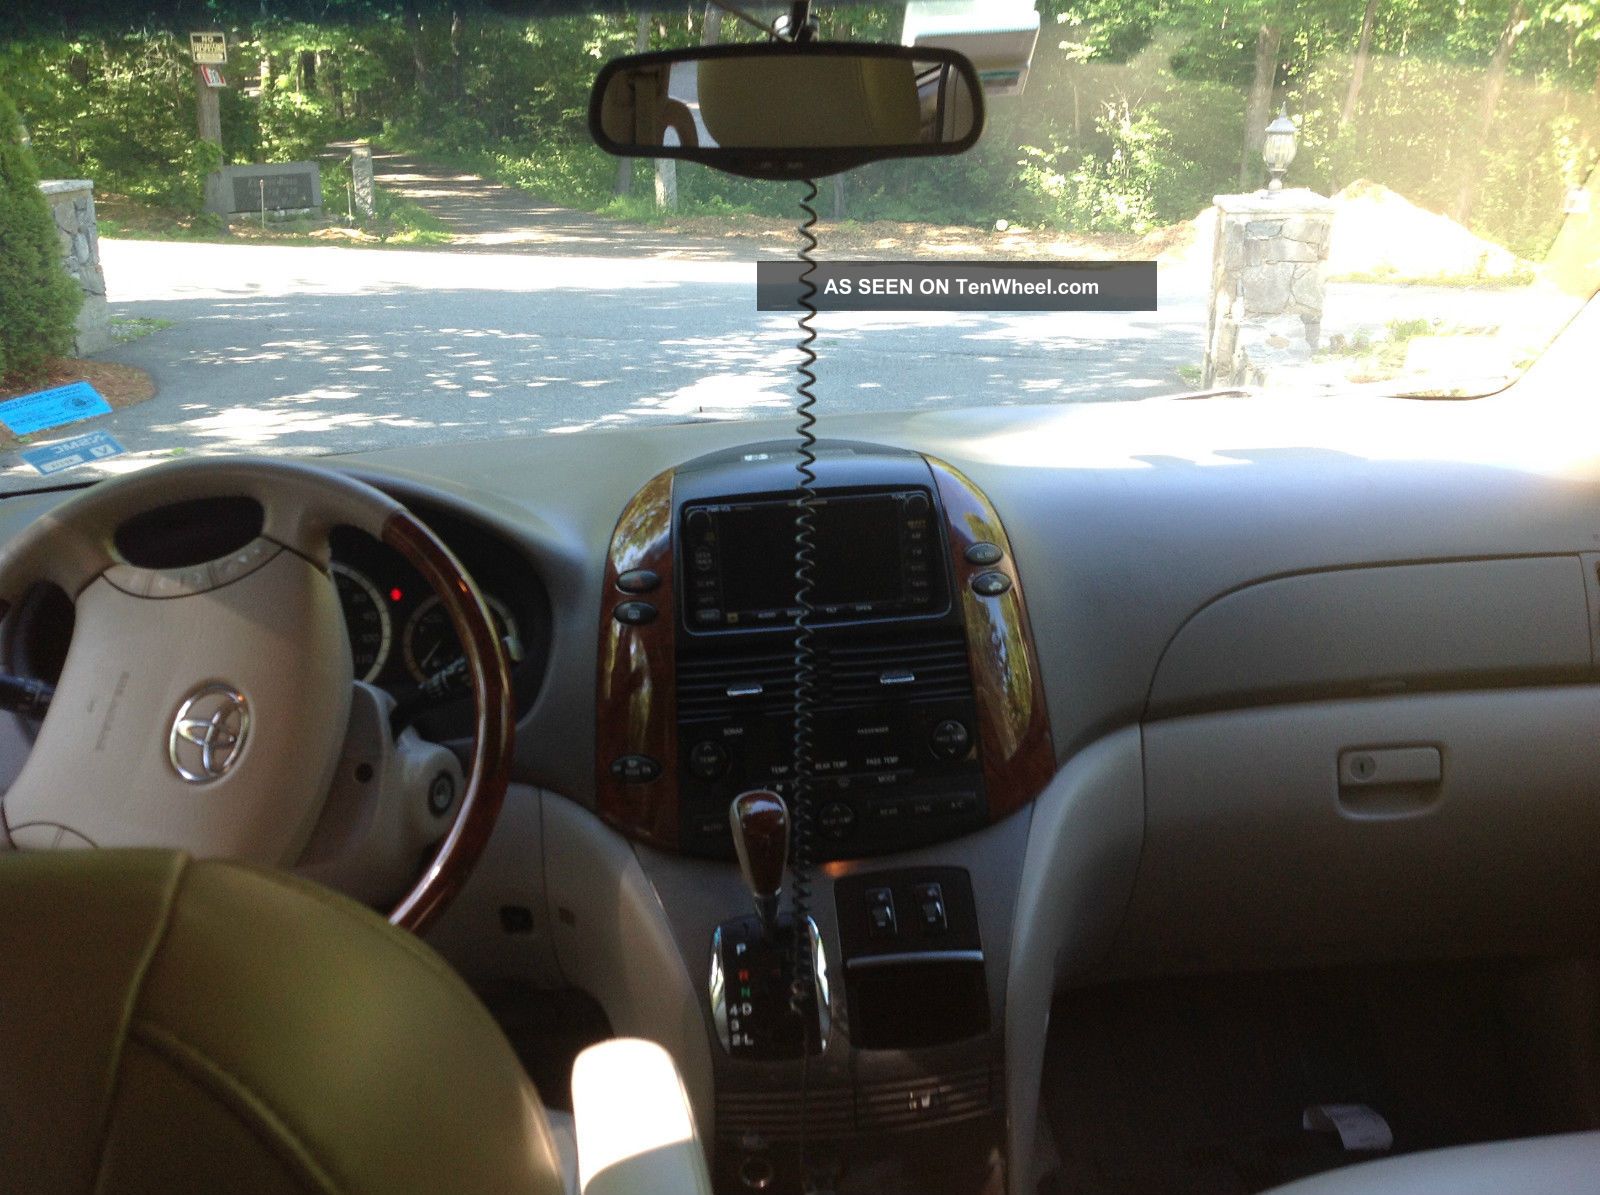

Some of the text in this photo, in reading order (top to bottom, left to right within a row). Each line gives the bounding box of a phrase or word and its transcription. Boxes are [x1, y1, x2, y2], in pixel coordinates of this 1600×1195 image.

[201, 35, 214, 44] NO
[736, 943, 746, 955] P
[741, 986, 751, 998] N
